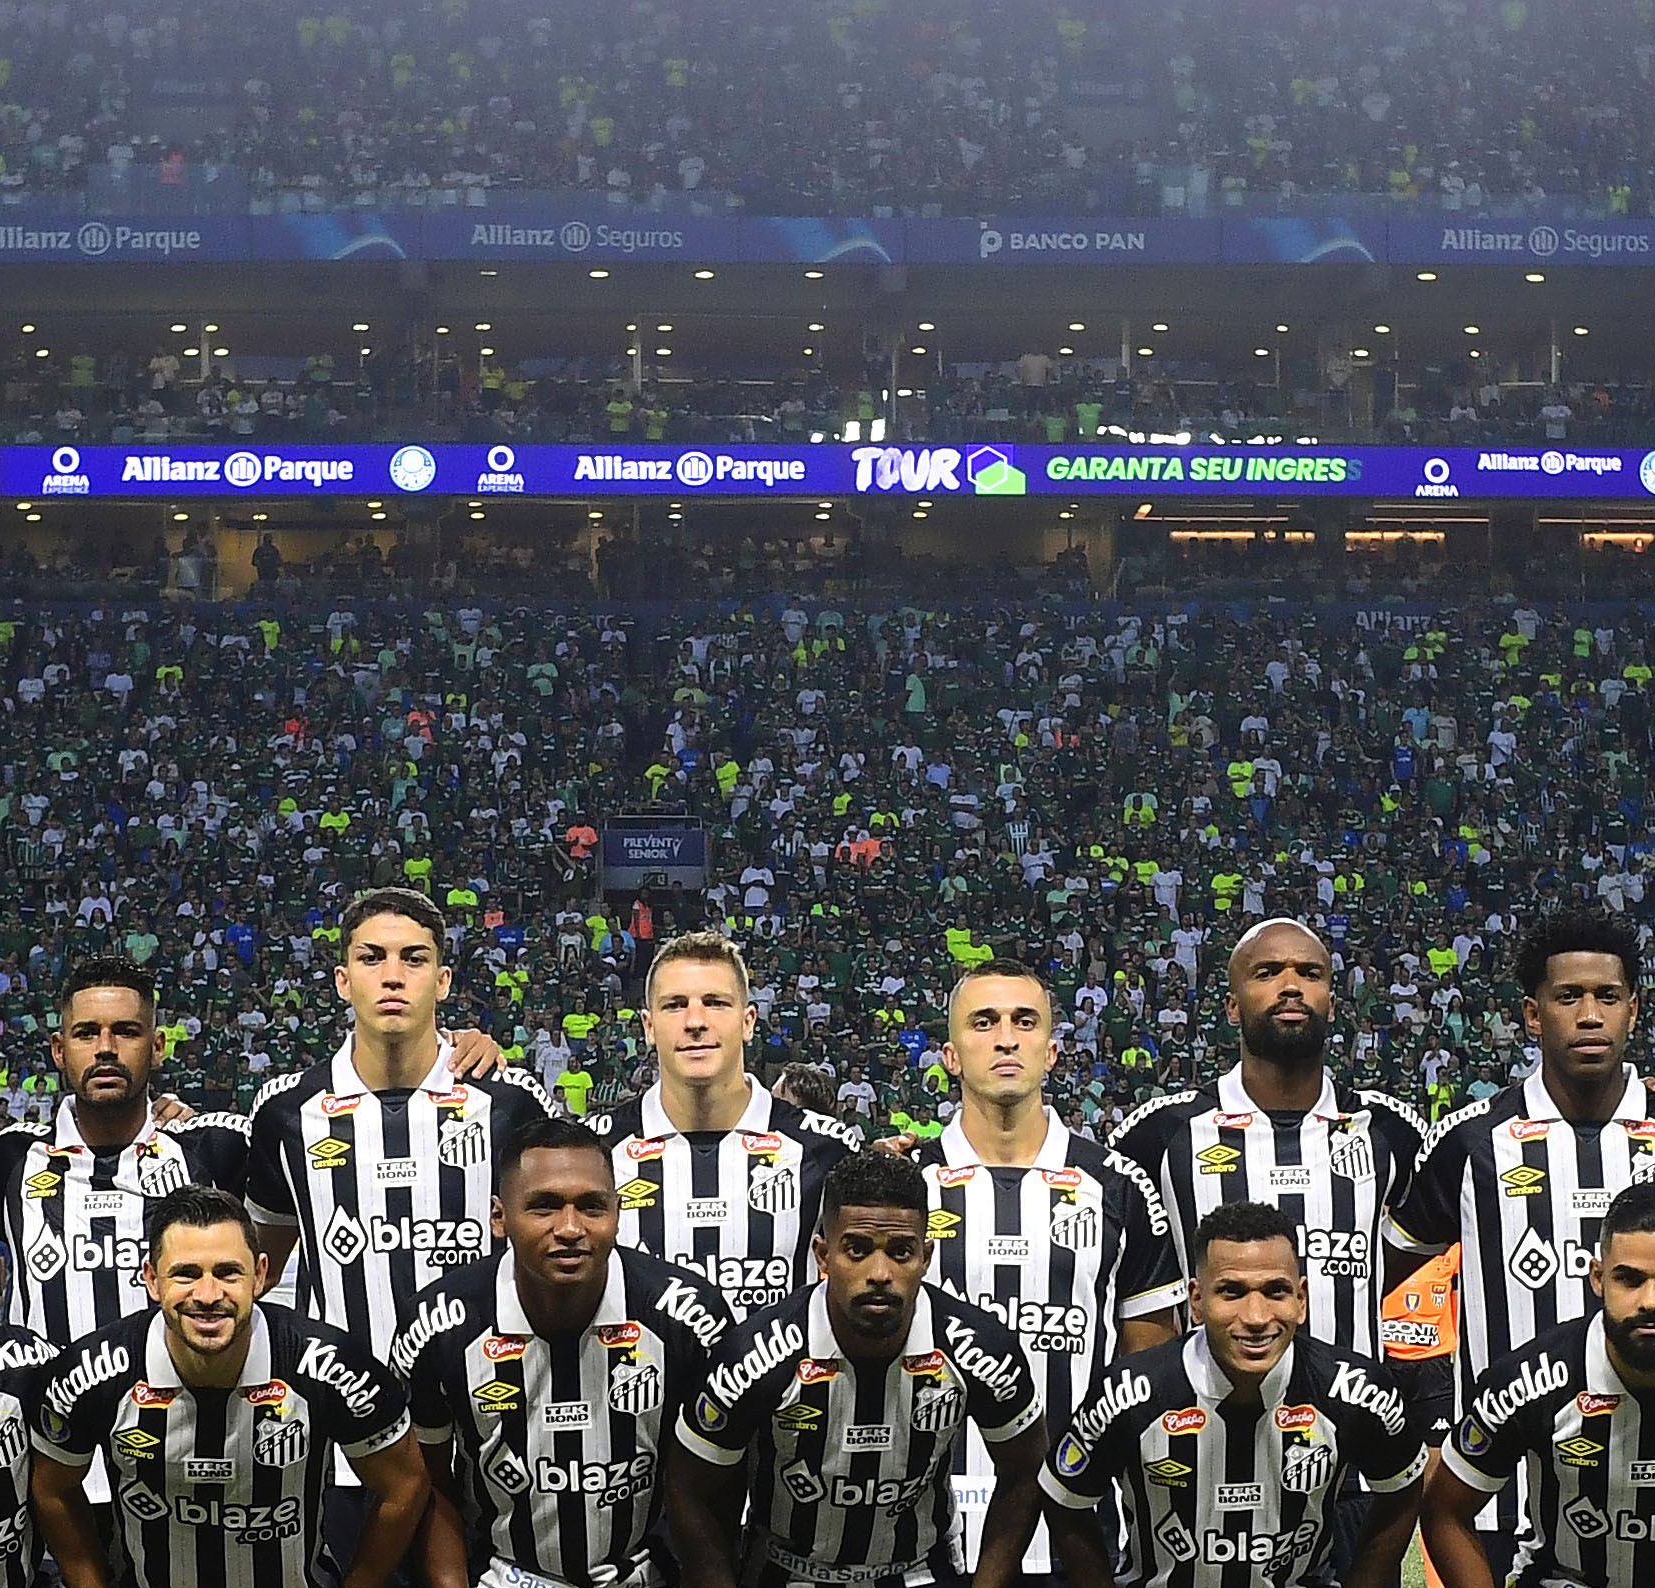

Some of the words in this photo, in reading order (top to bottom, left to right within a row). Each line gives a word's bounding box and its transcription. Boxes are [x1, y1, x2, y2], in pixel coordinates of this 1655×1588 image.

[116, 228, 201, 254] Parque
[471, 224, 555, 246] Allianz
[597, 226, 683, 253] Seguros
[1010, 232, 1088, 250] BANCO
[1096, 232, 1145, 250] PAN
[1441, 229, 1523, 251] Allianz
[1564, 230, 1649, 258] Seguros
[122, 458, 220, 481] Allianz
[265, 459, 353, 485] Parque
[575, 457, 672, 481] Allianz
[717, 459, 805, 485] Parque
[851, 448, 961, 491] TOUR
[1047, 458, 1183, 480] GARANTA
[1189, 458, 1245, 480] SEU
[1478, 453, 1538, 472] Allianz
[1565, 455, 1622, 476] Parque
[45, 474, 89, 486] ARENA
[478, 474, 524, 486] ARENA
[1415, 485, 1458, 497] ARENA
[623, 834, 674, 848] PREVENT
[627, 849, 668, 860] SENIOR
[313, 1158, 346, 1169] umbro
[377, 1162, 417, 1171] TEK
[1200, 1162, 1236, 1174] umbro
[377, 1170, 417, 1179] BOND
[1270, 1176, 1310, 1185] BOND
[1507, 1185, 1543, 1196] umbro
[687, 1210, 727, 1219] BOND
[371, 1217, 483, 1254] blaze
[1295, 1224, 1367, 1260] laze
[427, 1249, 480, 1265] .com
[988, 1248, 1029, 1257] BOND
[1321, 1259, 1367, 1277] .com
[735, 1287, 788, 1306] .com
[1031, 1333, 1085, 1353] .com
[706, 1318, 805, 1409] Kicaldo
[945, 1314, 1022, 1403] Kicaldo
[46, 1339, 130, 1419] Kicaldo
[297, 1336, 381, 1418] Kicaldo
[1472, 1352, 1569, 1434] Kicaldo
[480, 1401, 518, 1412] umbro
[546, 1404, 589, 1415] TEK
[546, 1414, 589, 1424] BOND
[846, 1435, 890, 1445] BOND
[847, 1427, 890, 1437] TEK
[188, 1460, 232, 1470] TEK
[188, 1469, 232, 1479] BOND
[539, 1454, 652, 1493] blaze
[1218, 1485, 1260, 1495] TEK
[1218, 1494, 1260, 1504] BOND
[176, 1496, 301, 1531] blaze
[1207, 1520, 1317, 1562] blaze
